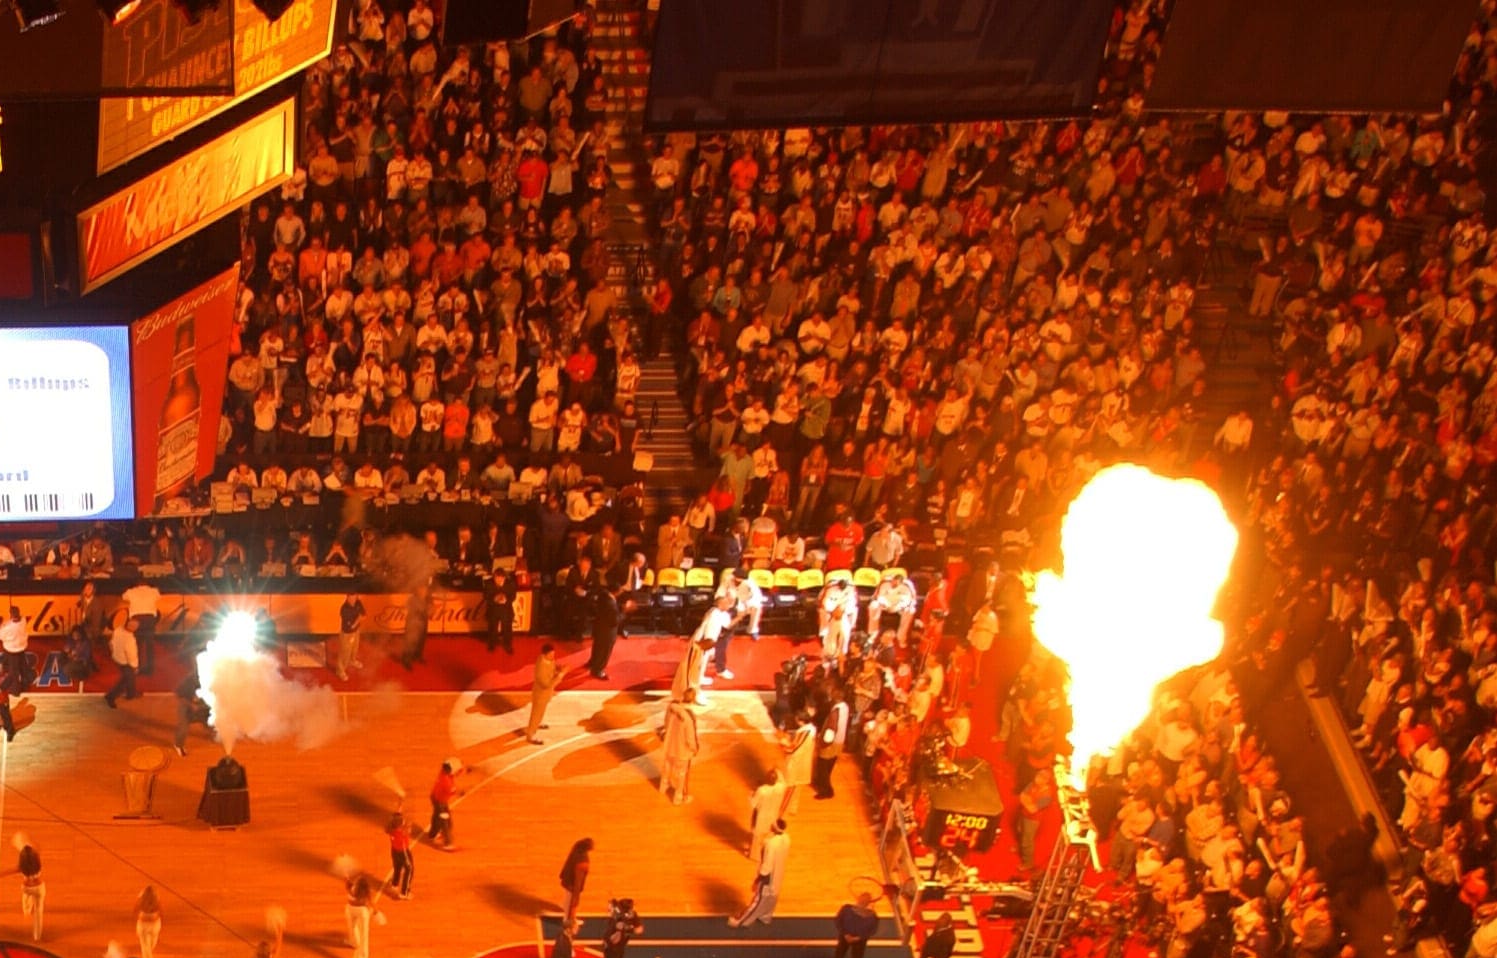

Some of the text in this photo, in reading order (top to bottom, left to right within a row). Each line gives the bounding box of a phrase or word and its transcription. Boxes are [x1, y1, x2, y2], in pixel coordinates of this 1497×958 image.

[136, 277, 235, 345] Budweiser
[945, 813, 988, 830] 12:00
[940, 826, 978, 848] 24
